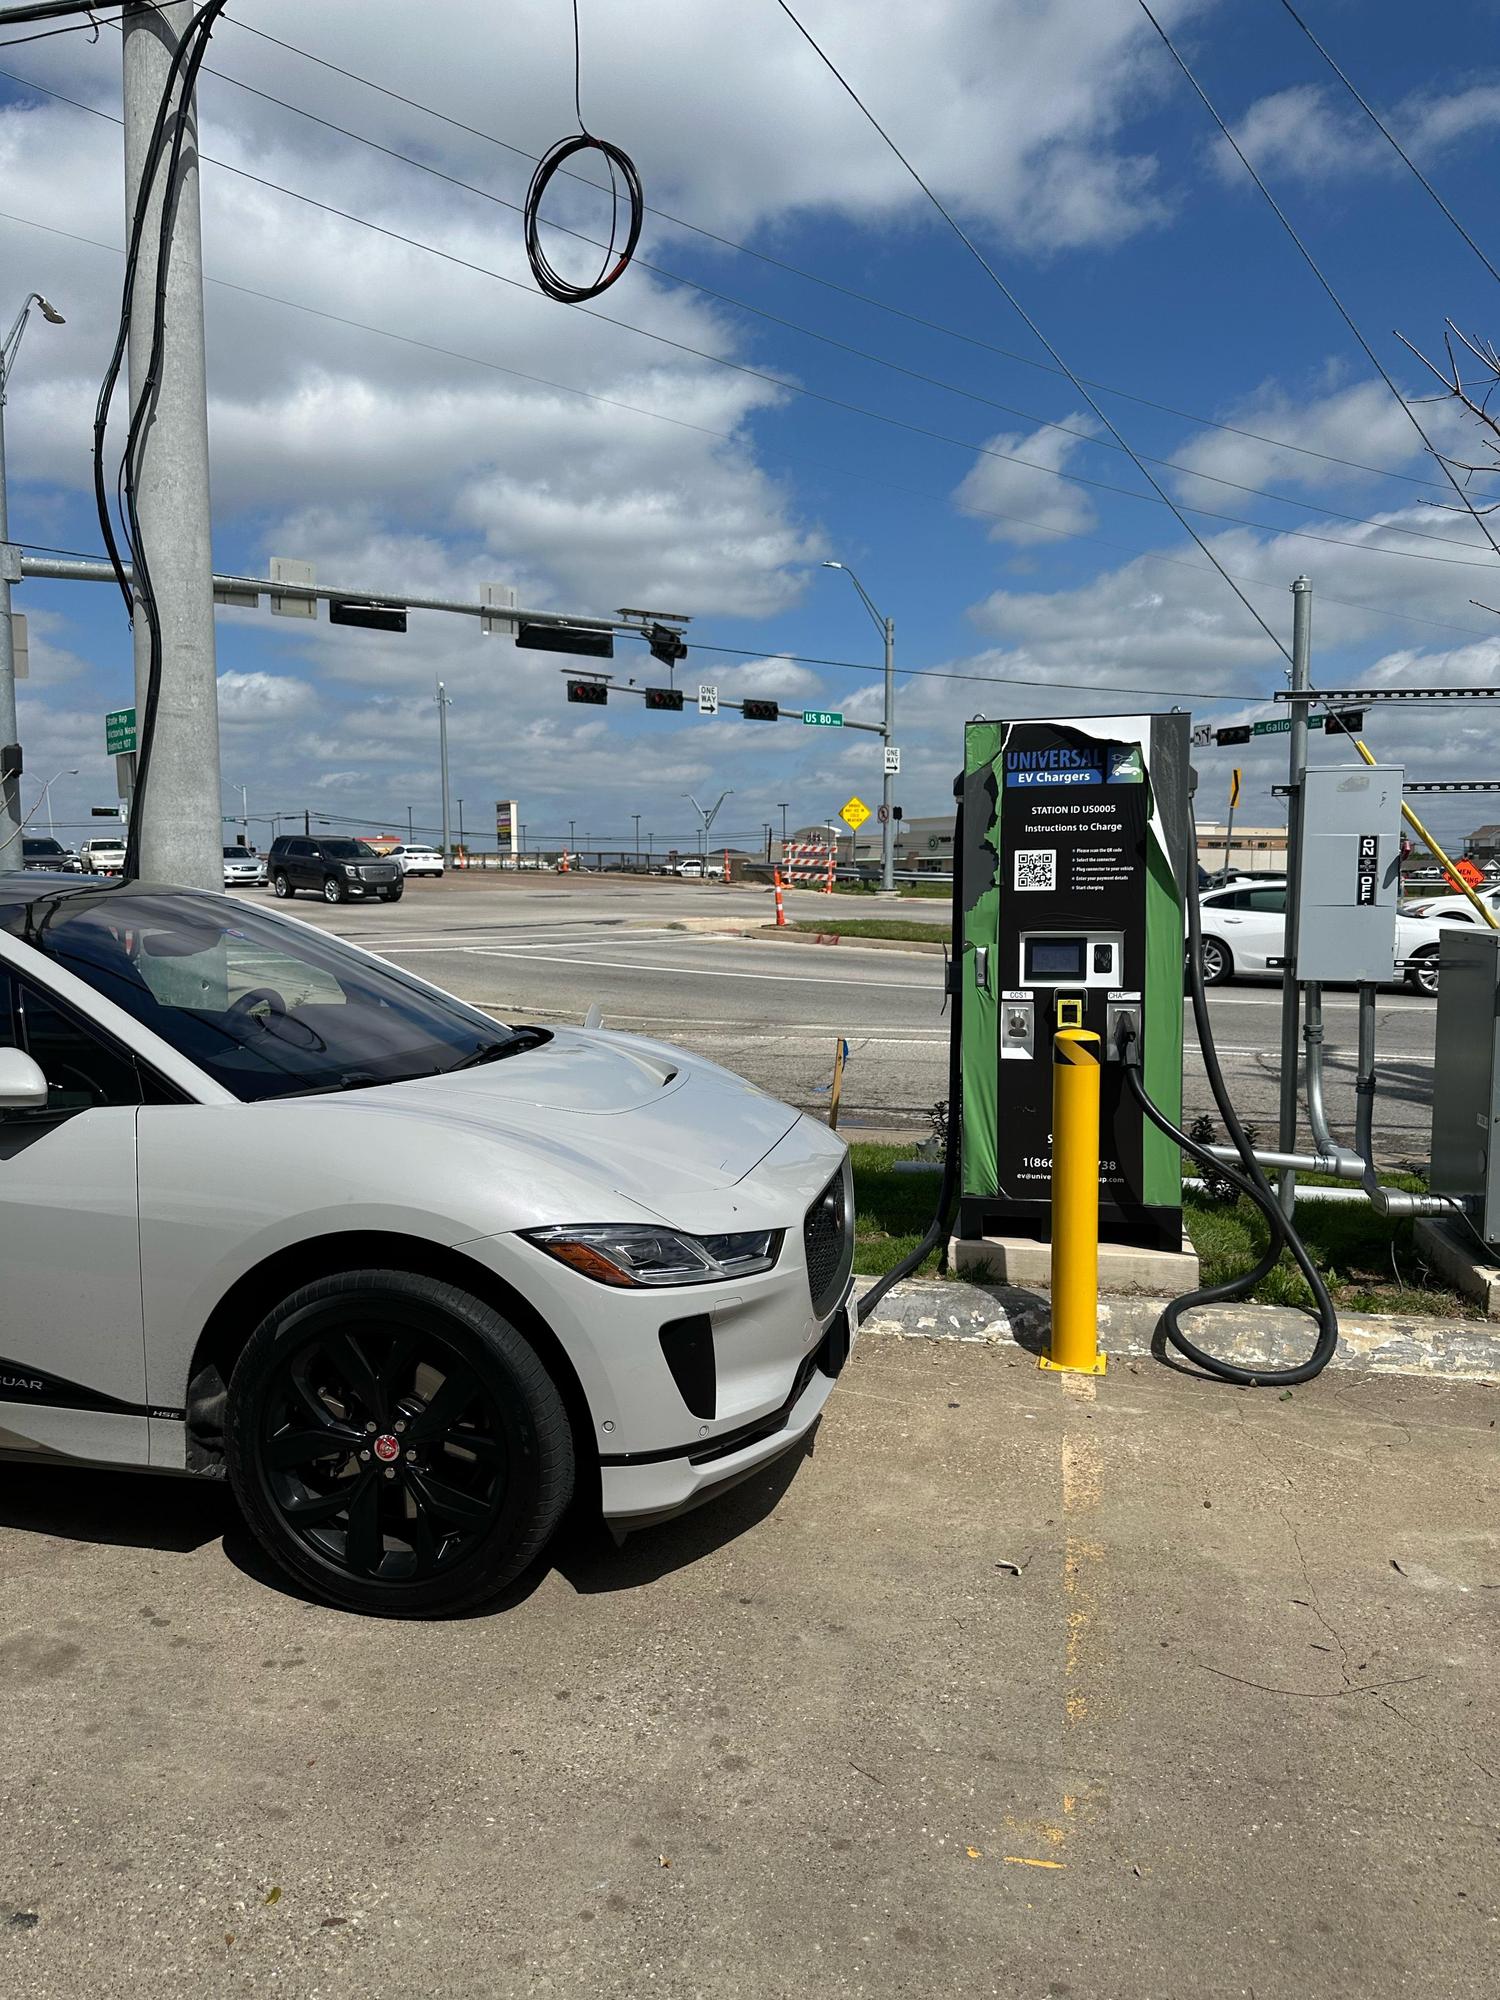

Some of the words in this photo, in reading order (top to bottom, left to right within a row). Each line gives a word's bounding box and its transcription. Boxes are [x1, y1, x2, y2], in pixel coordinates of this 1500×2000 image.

[701, 686, 716, 695] ONE
[701, 695, 717, 704] WAY
[805, 713, 817, 724] US
[819, 714, 831, 725] 80
[1265, 721, 1291, 732] Gallo
[886, 749, 898, 757] ONE
[1007, 749, 1103, 770] UNIVERSAL
[1018, 773, 1033, 783] EV
[1036, 772, 1091, 784] Chargers
[1031, 806, 1068, 815] STATION
[1070, 805, 1080, 814] ID
[1082, 804, 1116, 814] US0005
[1025, 823, 1077, 832] Instructions
[1079, 823, 1089, 831] to
[1090, 822, 1123, 832] Charge
[1362, 839, 1375, 856] ON
[1447, 875, 1479, 884] WKING
[1361, 876, 1373, 901] OFF
[1009, 991, 1027, 999] CCS1
[0, 1375, 43, 1390] UAR
[152, 1410, 180, 1419] HSE
